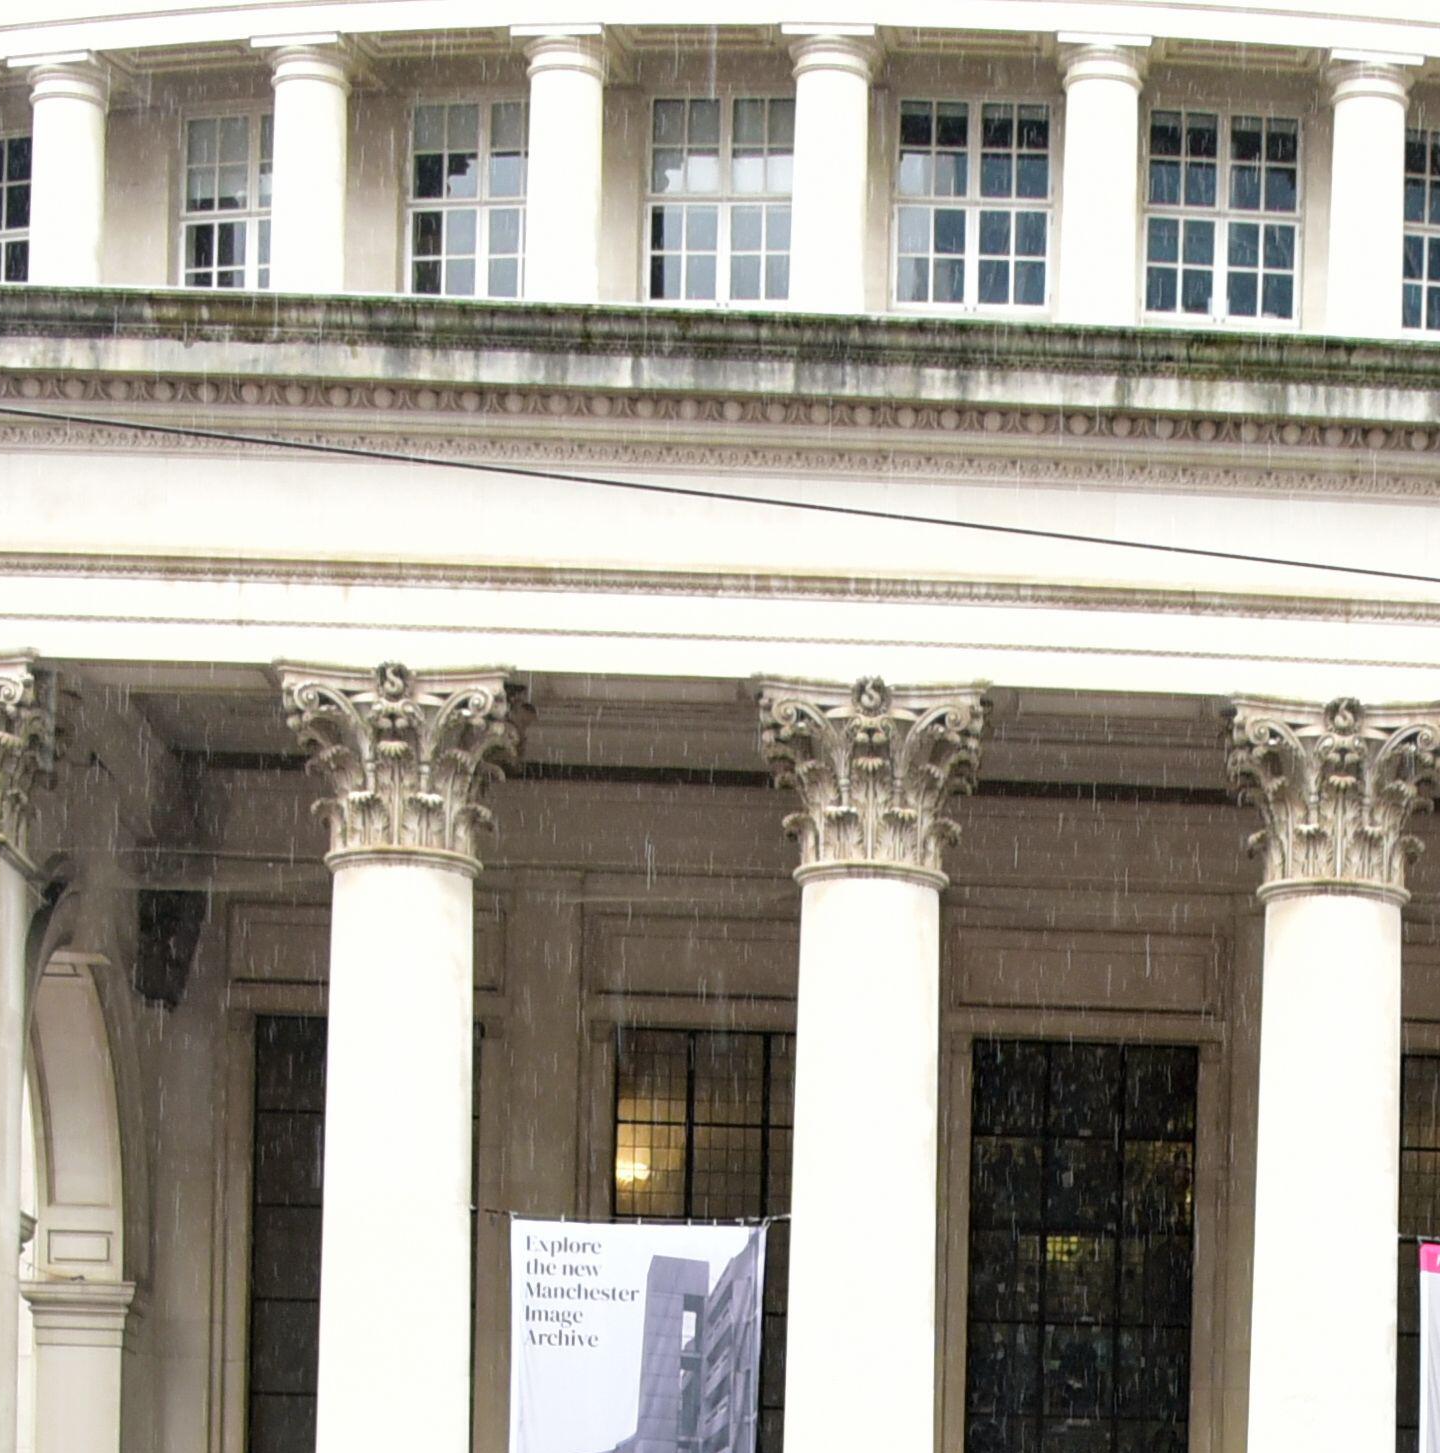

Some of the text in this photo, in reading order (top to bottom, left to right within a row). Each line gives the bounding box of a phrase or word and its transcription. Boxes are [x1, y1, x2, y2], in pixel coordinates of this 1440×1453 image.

[526, 1235, 602, 1258] Explore
[526, 1258, 602, 1277] the new
[526, 1281, 640, 1302] Manchester
[525, 1305, 583, 1328] Image
[526, 1329, 599, 1348] Archive
